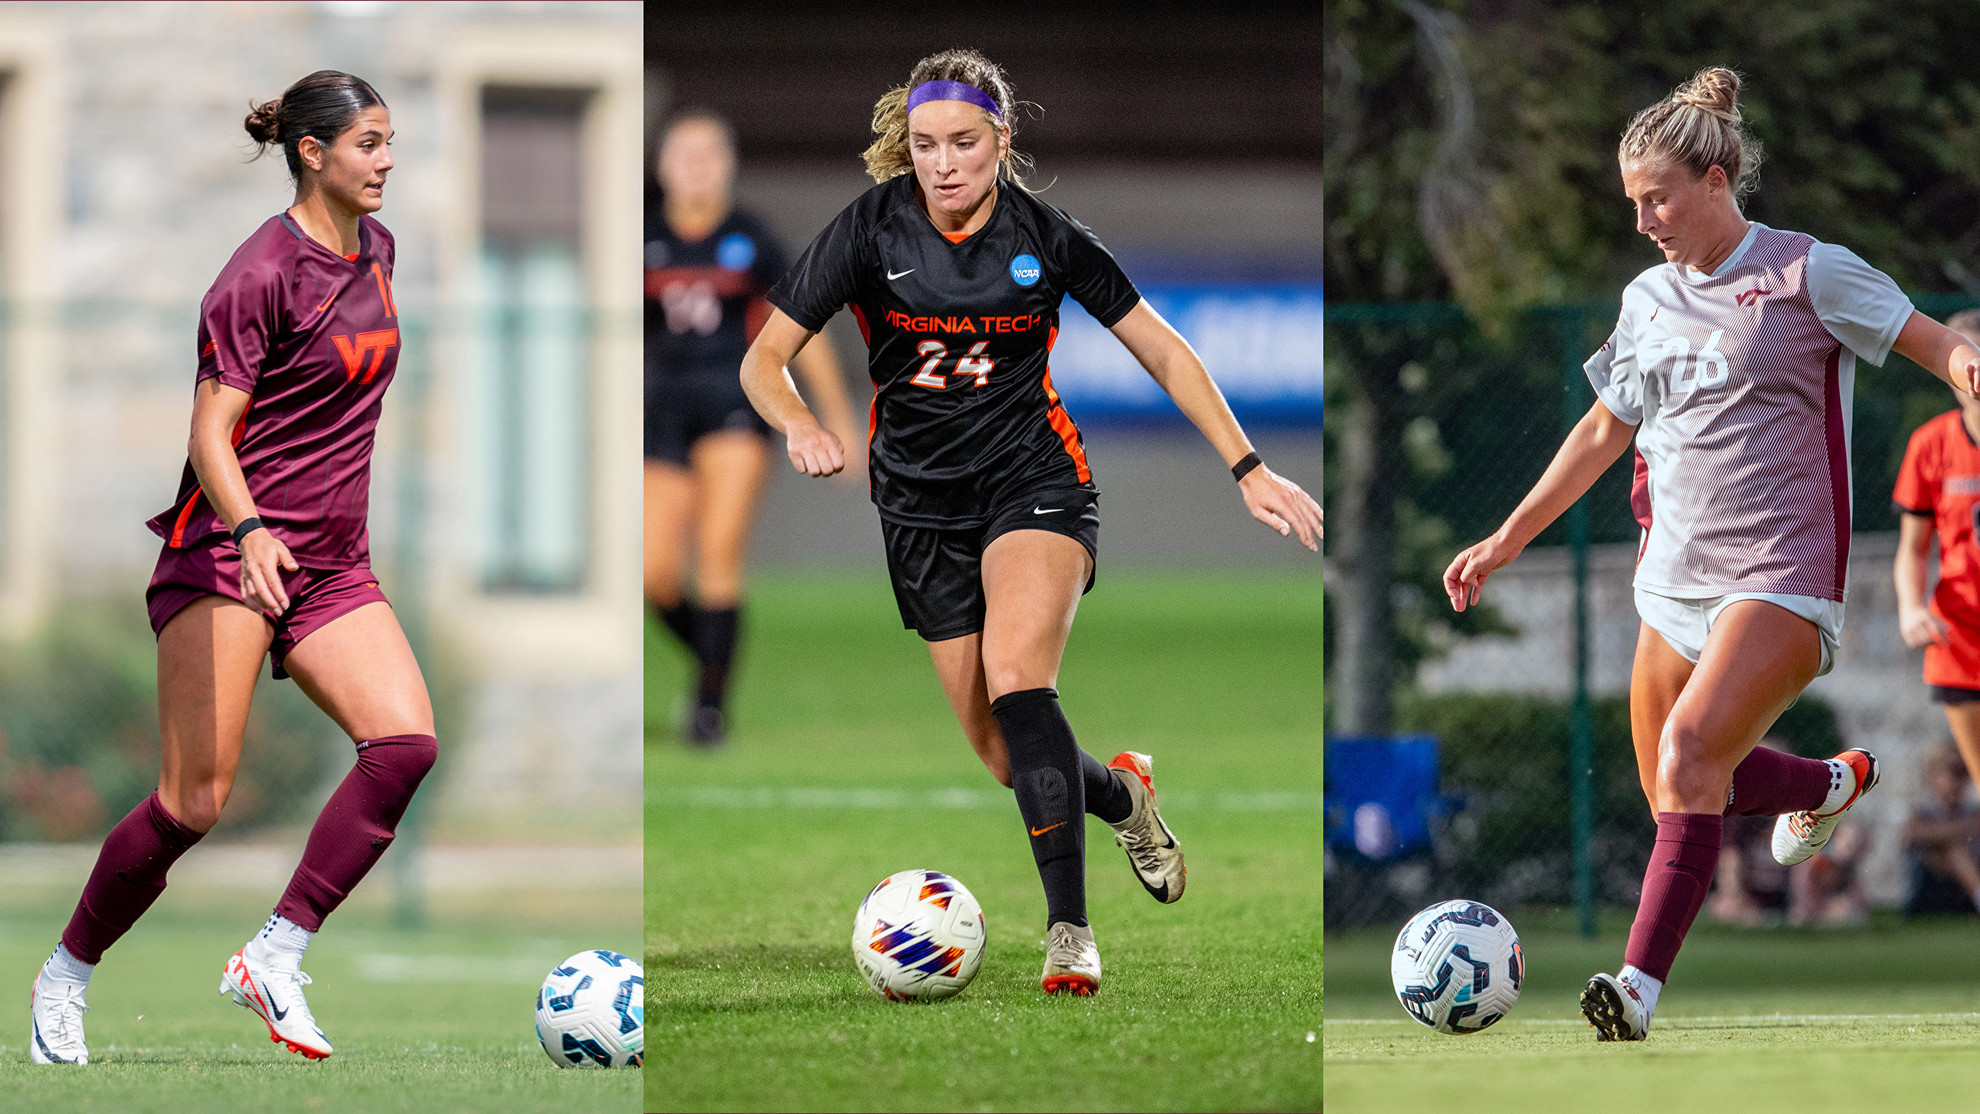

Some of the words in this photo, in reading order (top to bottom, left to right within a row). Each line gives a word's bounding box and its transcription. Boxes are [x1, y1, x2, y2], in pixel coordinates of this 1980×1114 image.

[1014, 269, 1040, 278] NCAA
[880, 304, 977, 334] VIRGINIA
[979, 314, 1041, 333] TECH
[331, 327, 398, 385] VT
[909, 338, 995, 390] 24
[1661, 329, 1730, 395] 26
